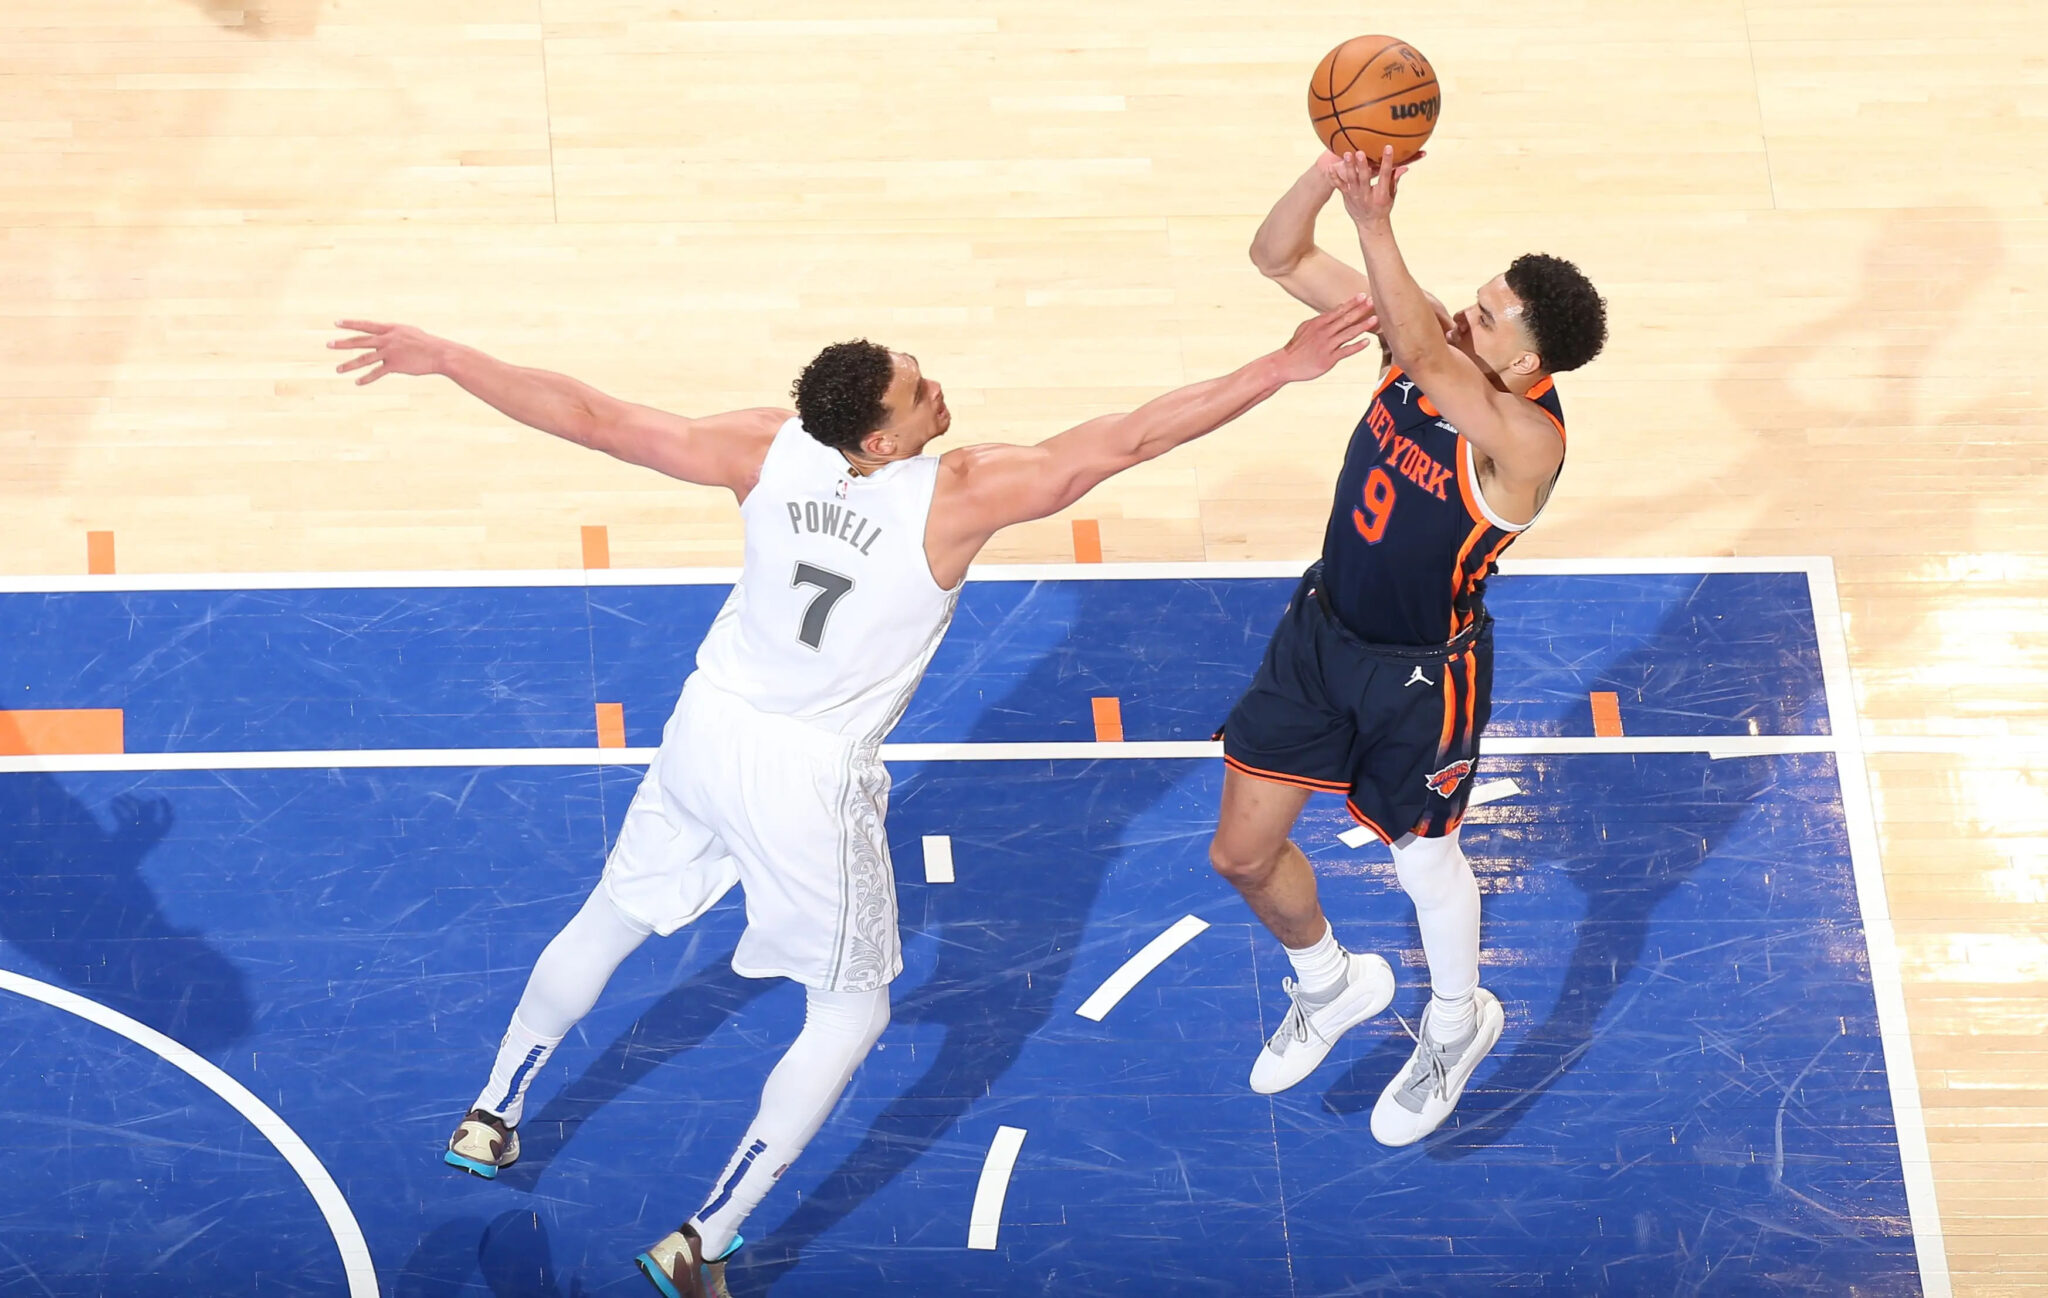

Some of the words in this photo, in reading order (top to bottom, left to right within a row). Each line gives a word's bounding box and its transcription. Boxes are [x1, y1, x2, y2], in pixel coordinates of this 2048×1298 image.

[1366, 398, 1395, 452] NEW
[1385, 434, 1454, 501] YORK
[786, 501, 882, 556] POWELL
[1352, 465, 1397, 546] 9
[789, 559, 856, 652] 7
